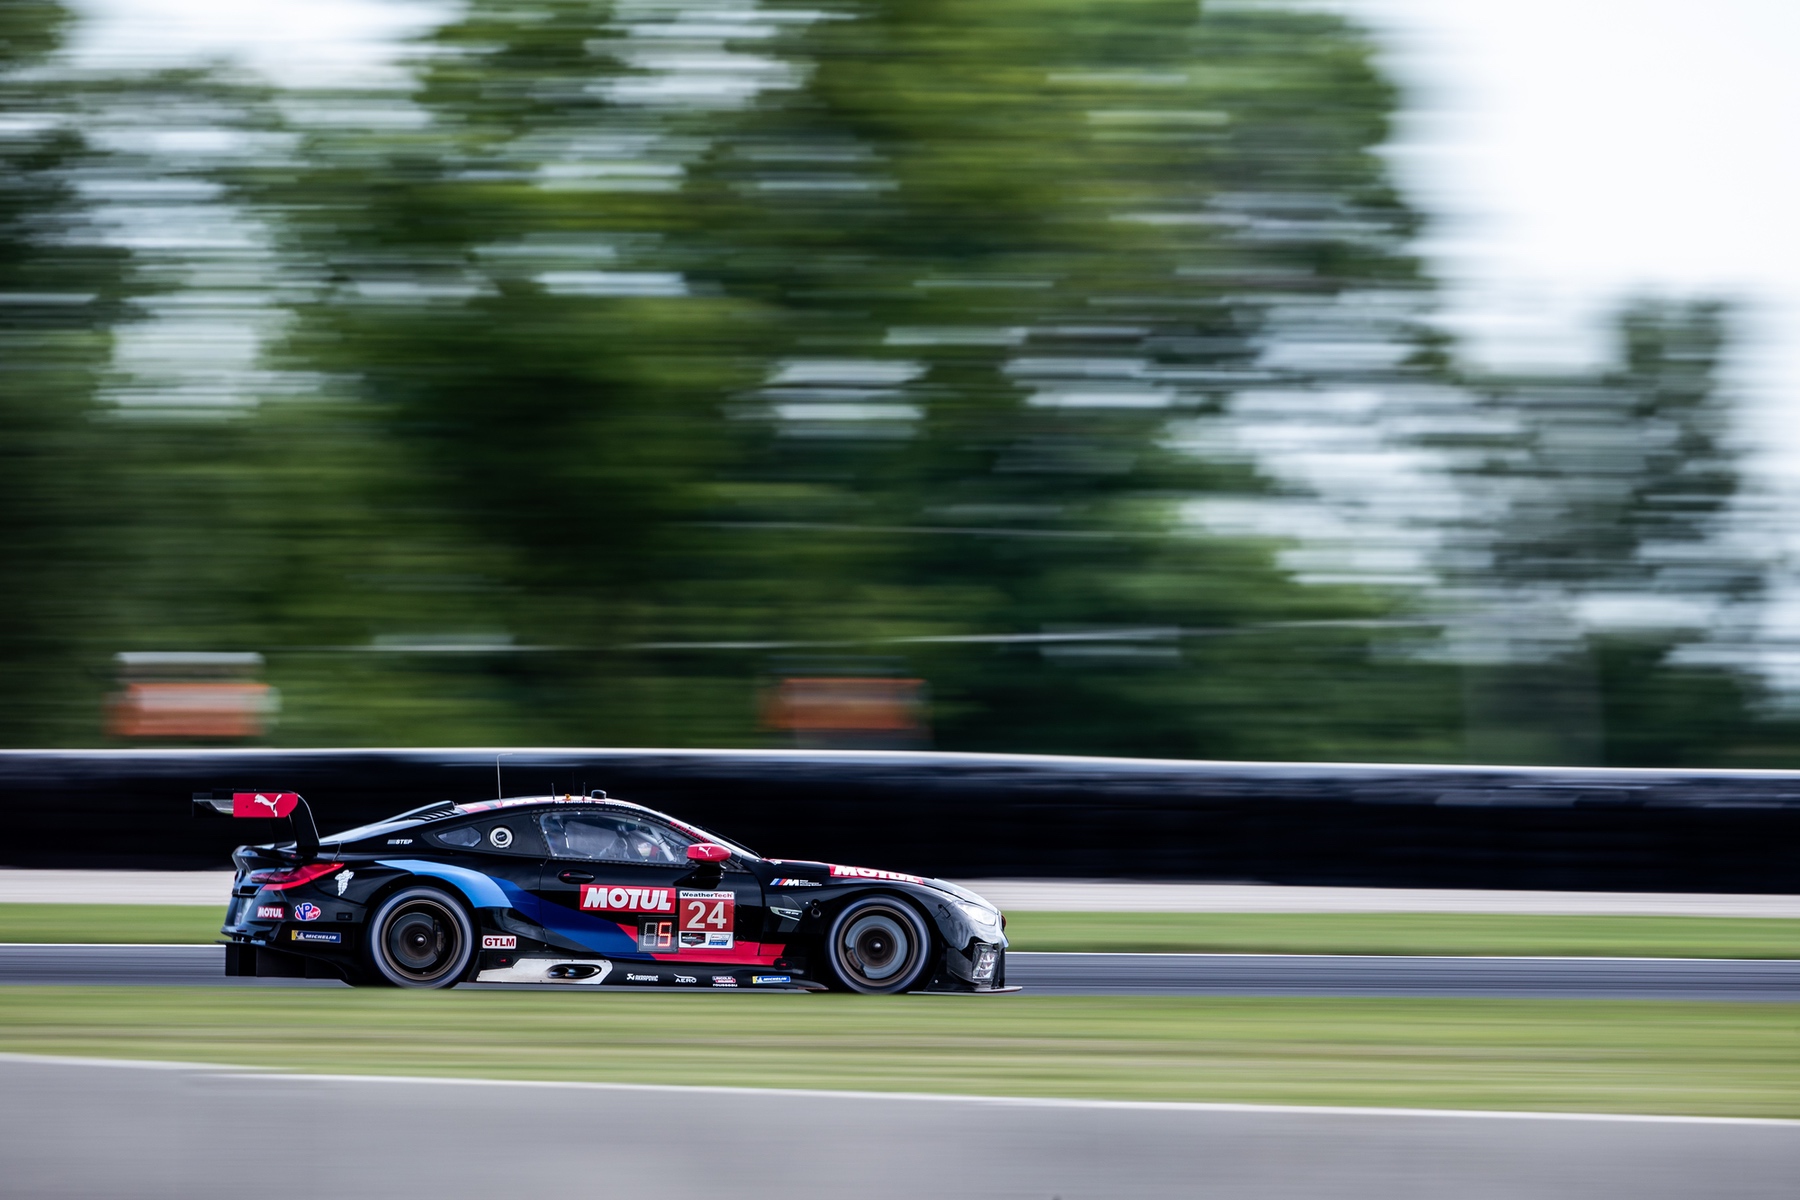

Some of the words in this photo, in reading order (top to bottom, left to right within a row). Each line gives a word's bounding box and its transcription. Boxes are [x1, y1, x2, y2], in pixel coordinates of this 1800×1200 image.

[834, 866, 920, 884] MOTUL
[583, 887, 672, 910] MOTUL
[257, 907, 282, 918] MOTUL
[295, 903, 313, 920] VP
[687, 901, 727, 929] 24
[484, 938, 515, 947] GTLM
